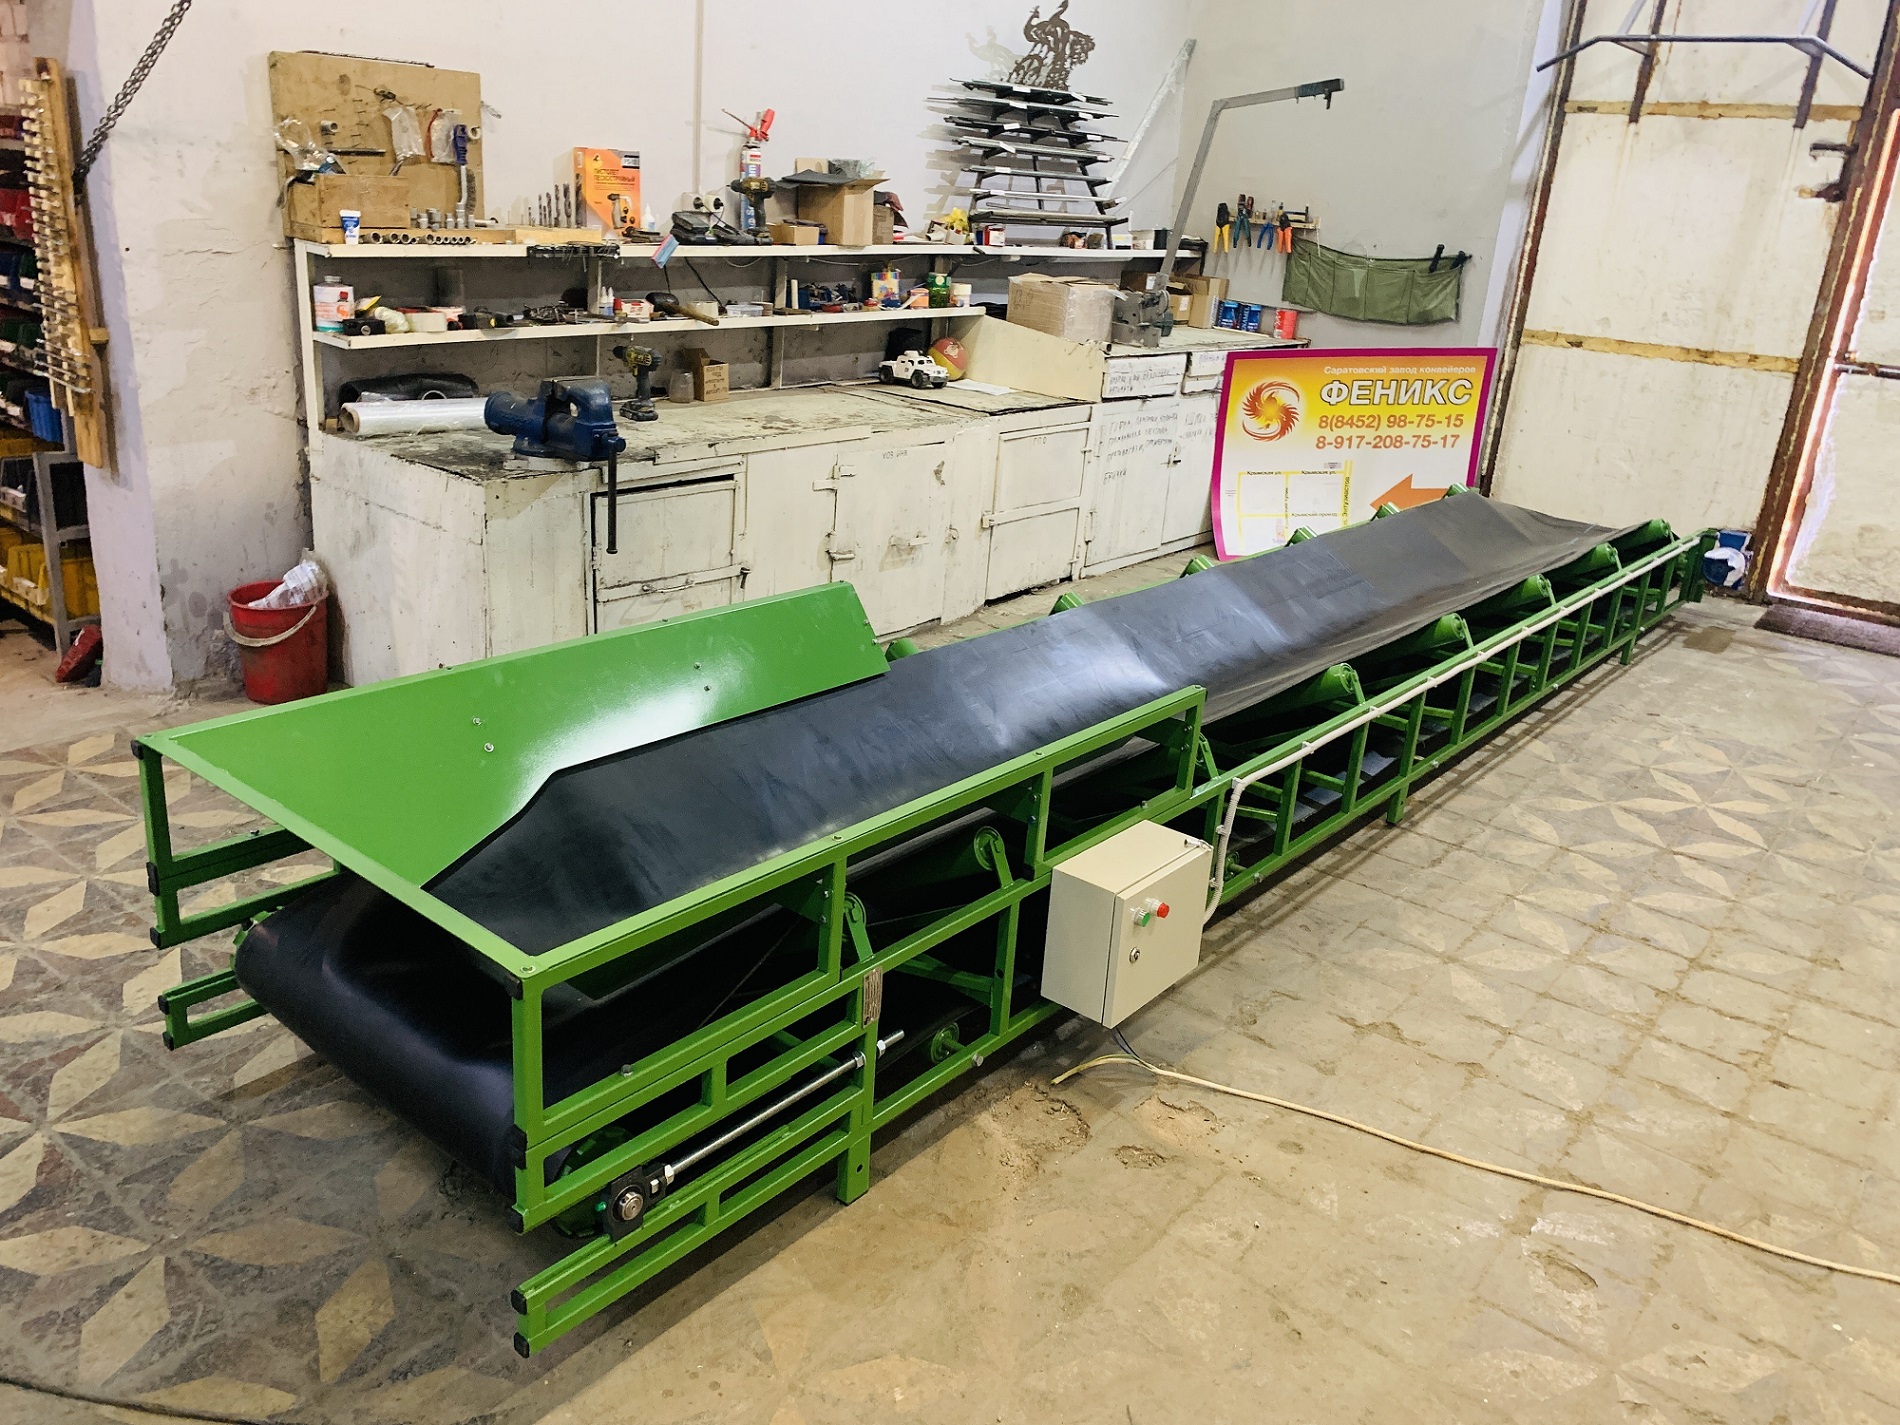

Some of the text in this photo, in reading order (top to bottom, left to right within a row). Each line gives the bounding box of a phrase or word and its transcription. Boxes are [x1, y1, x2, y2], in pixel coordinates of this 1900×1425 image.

[1323, 365, 1476, 375] Саратовский завод конвейеров
[1320, 378, 1473, 406] ФЕНИКС
[1318, 414, 1464, 432] 8(8452) 98-75-15
[1315, 434, 1460, 449] 8-917-208-75-17
